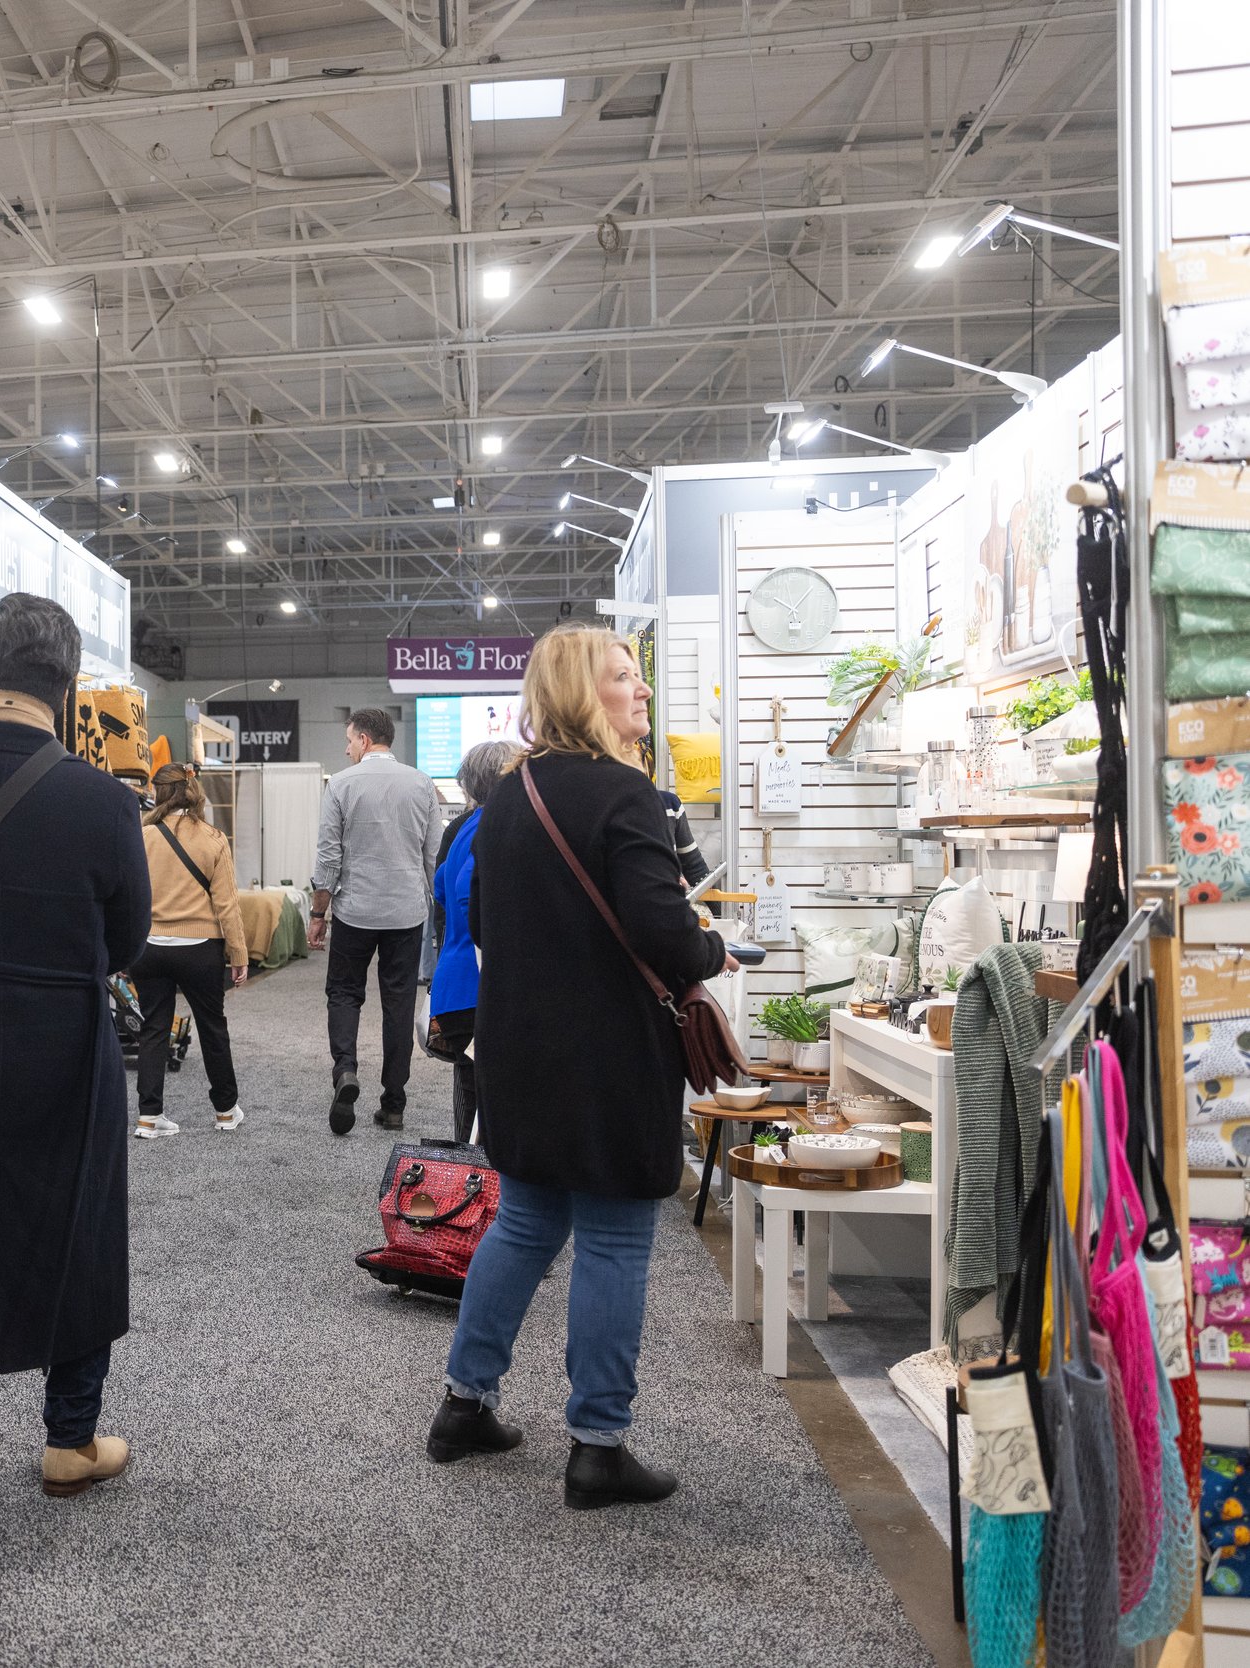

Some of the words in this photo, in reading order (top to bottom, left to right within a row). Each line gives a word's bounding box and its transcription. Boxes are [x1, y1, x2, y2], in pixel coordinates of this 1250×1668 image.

[394, 647, 452, 671] Bella
[1178, 720, 1204, 733] ECO
[241, 731, 292, 745] EATERY
